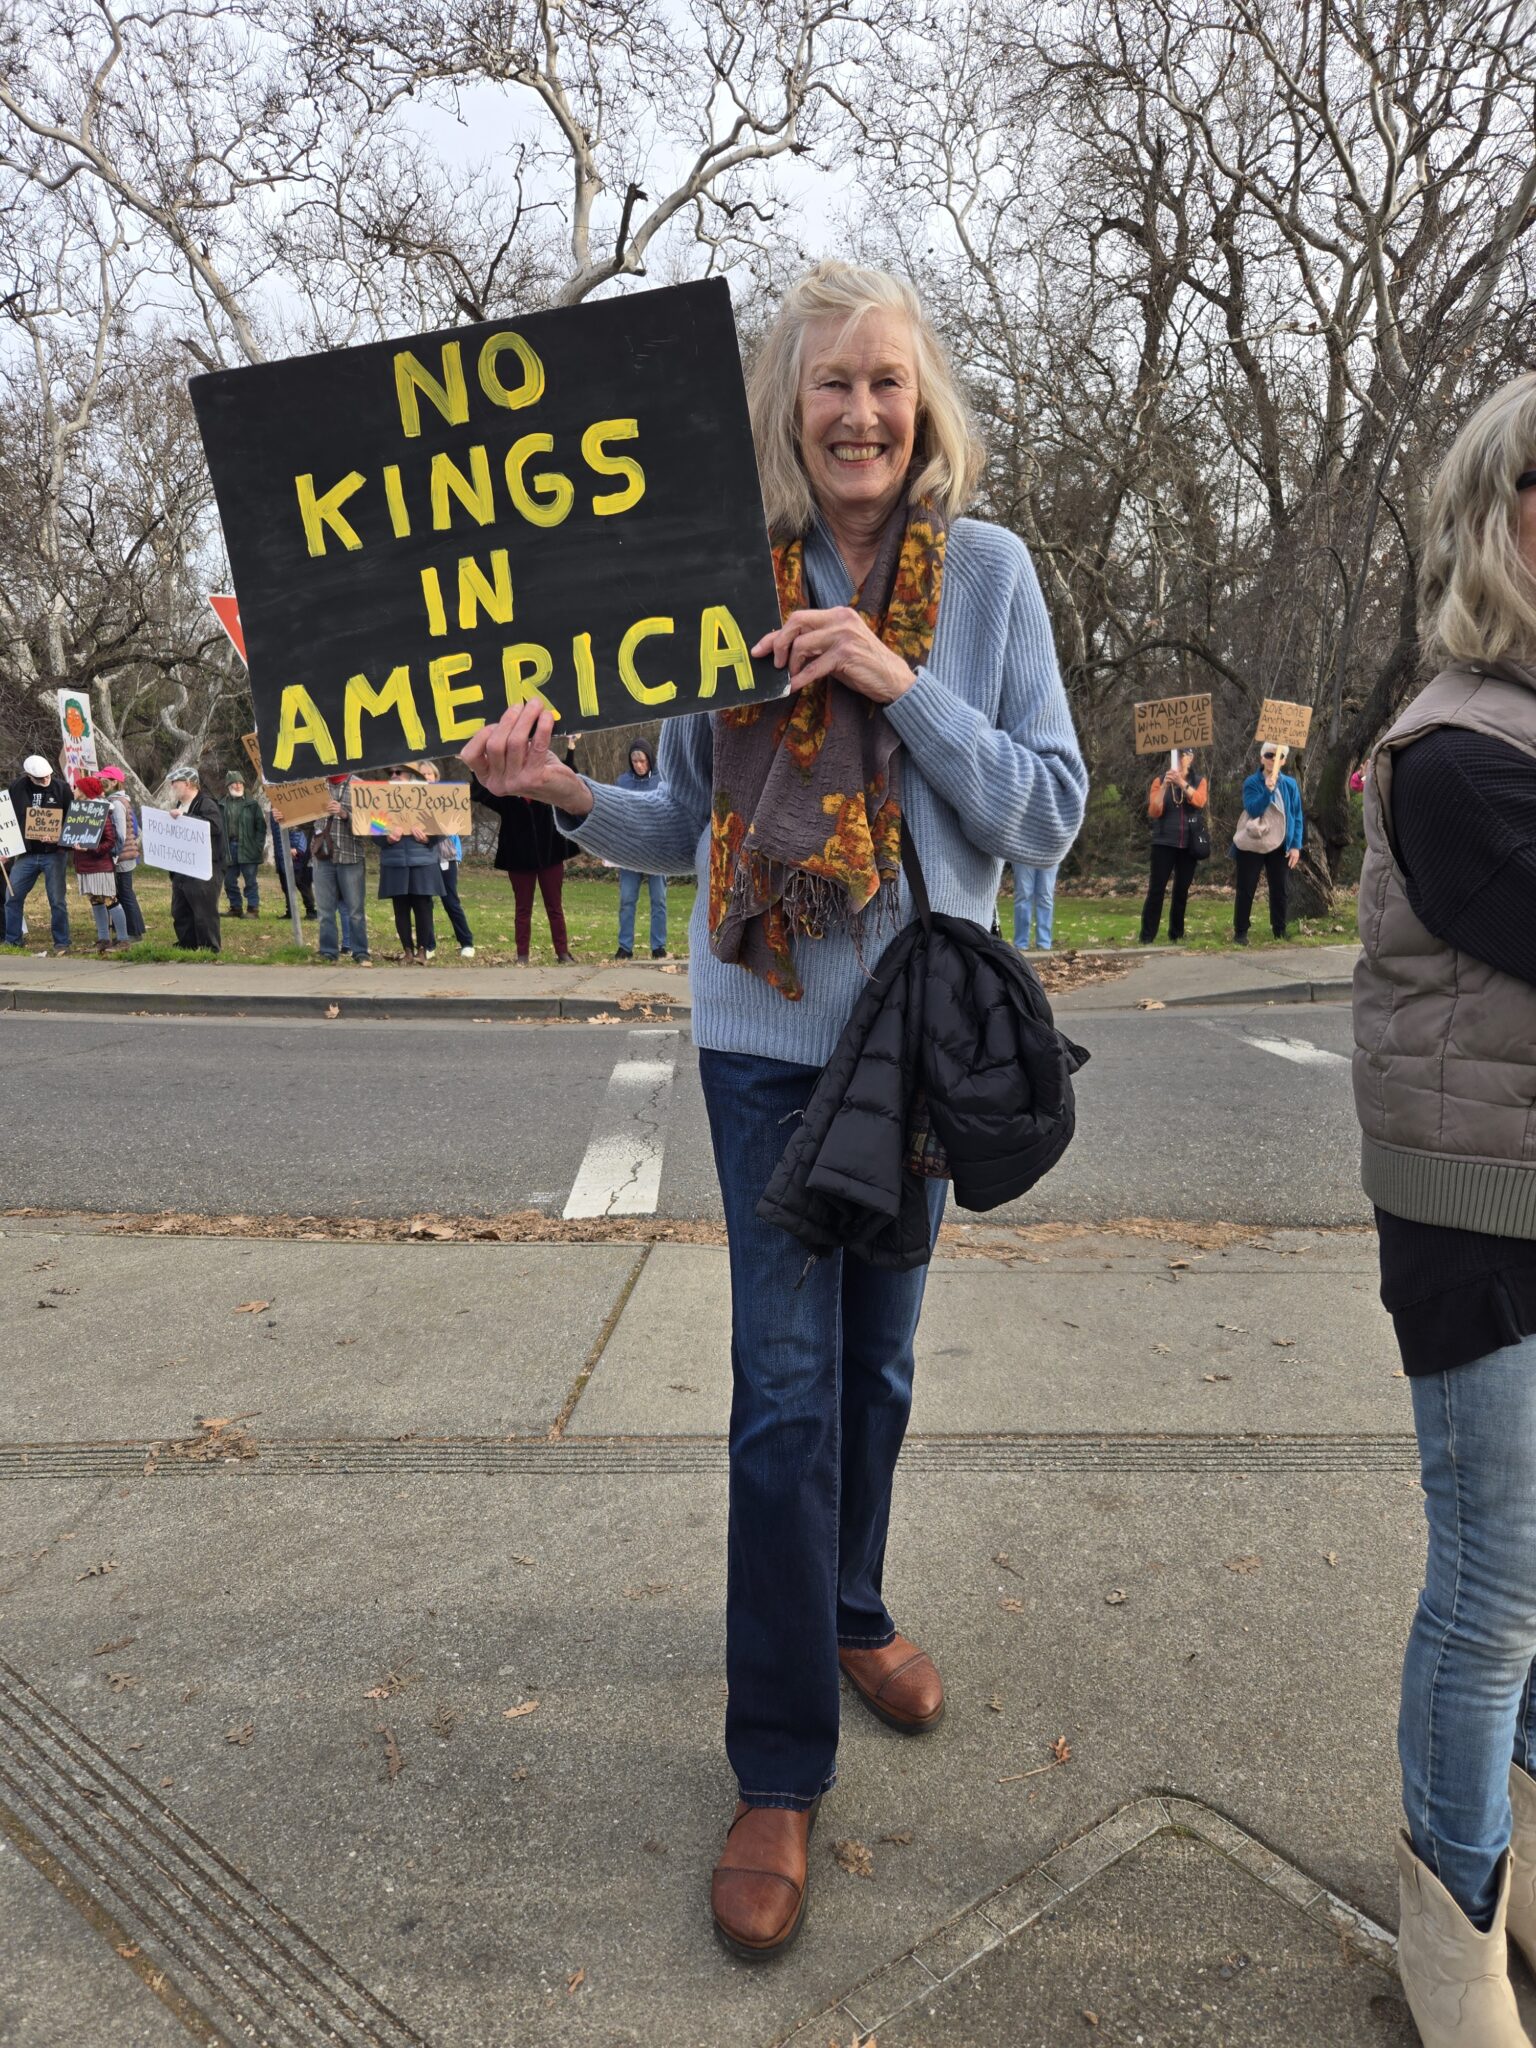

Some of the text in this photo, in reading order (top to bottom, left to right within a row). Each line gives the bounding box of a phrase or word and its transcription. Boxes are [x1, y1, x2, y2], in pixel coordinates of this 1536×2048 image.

[394, 331, 545, 437] NO
[294, 418, 646, 557] KINGS
[420, 549, 514, 637] IN
[272, 605, 755, 771] AMERICA
[1138, 697, 1209, 718] STAND UP
[1167, 713, 1207, 730] PEACE
[1142, 727, 1209, 748] AND LOVE
[353, 786, 380, 810] We
[411, 786, 469, 813] People
[29, 808, 53, 818] OMG
[35, 817, 46, 826] 86
[148, 819, 205, 845] PRO-AMERICAN
[148, 842, 196, 865] ANTI-FASCIST
